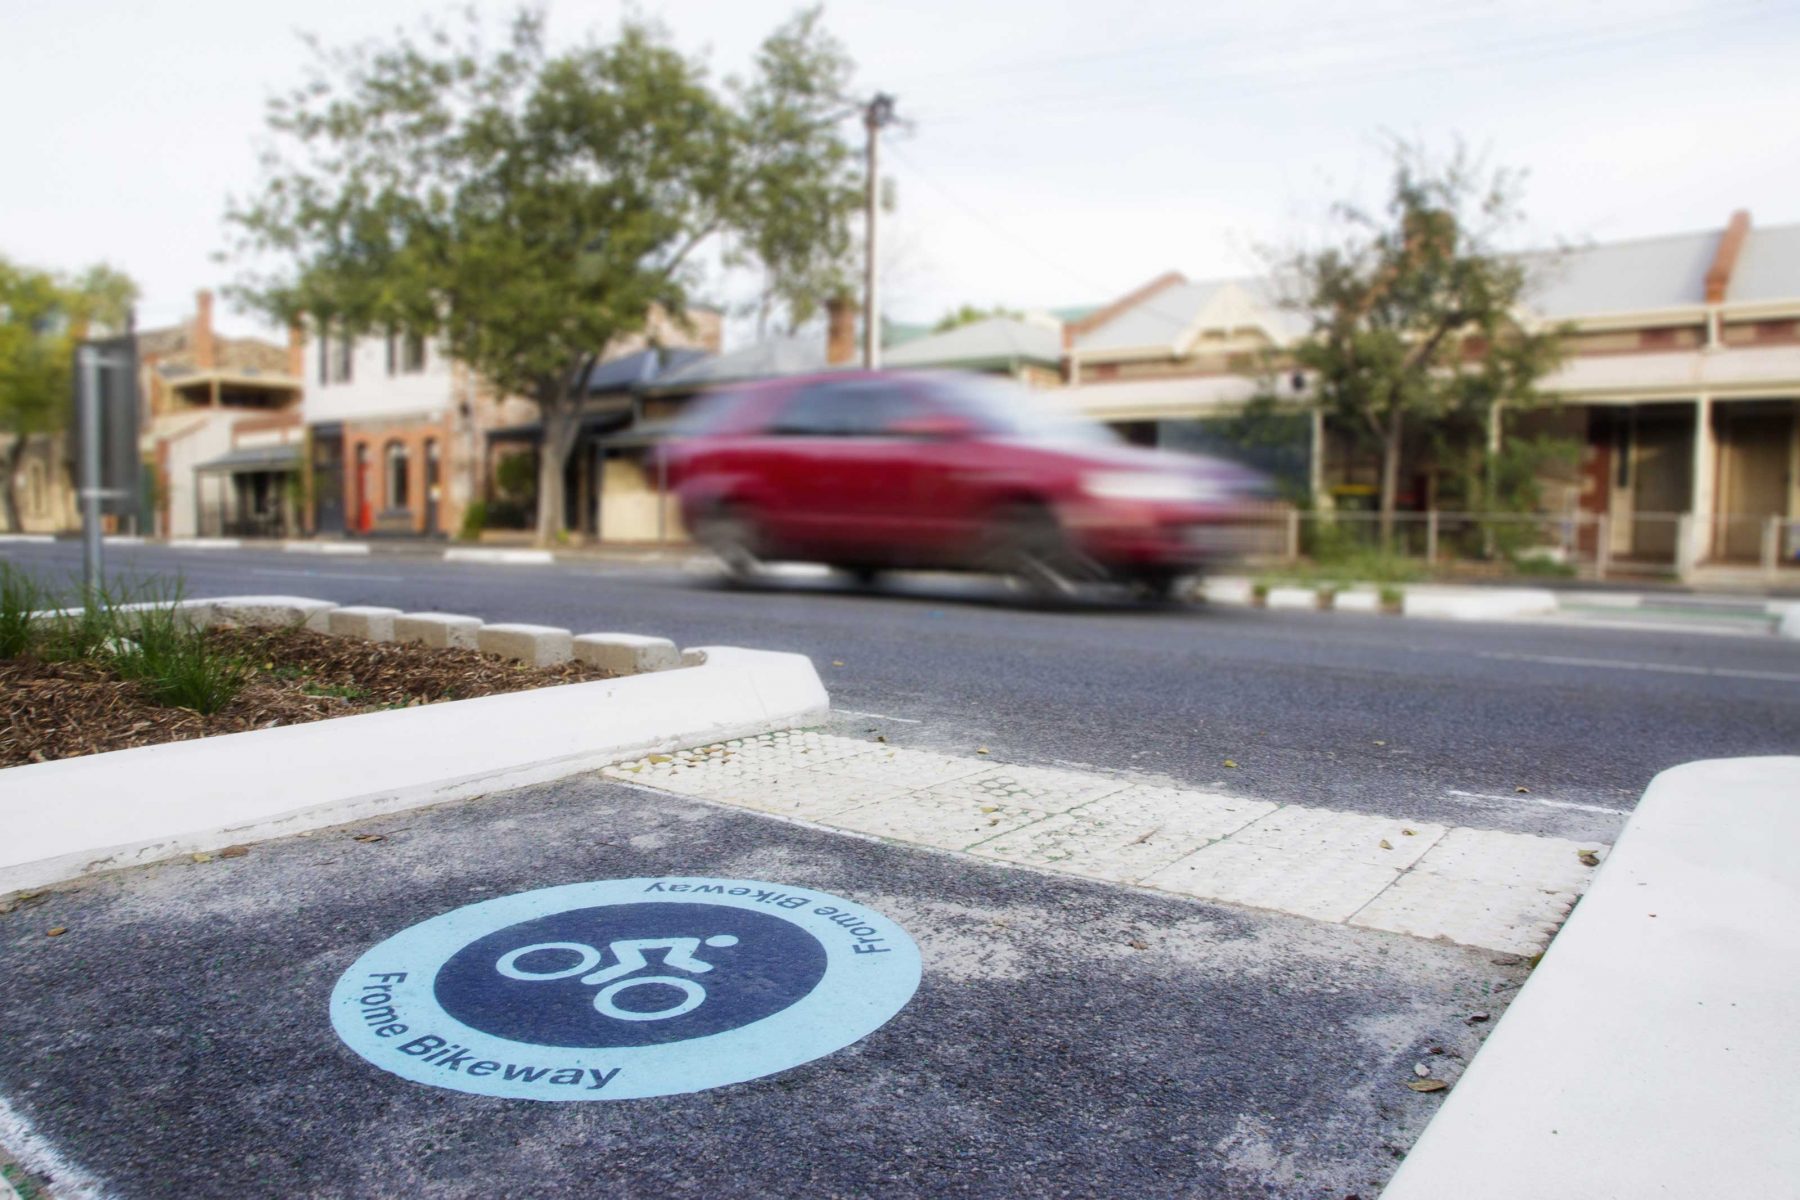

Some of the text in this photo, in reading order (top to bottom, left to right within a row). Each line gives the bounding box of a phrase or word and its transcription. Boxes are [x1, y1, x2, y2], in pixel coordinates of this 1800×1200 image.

[646, 882, 891, 955] Frome Bikeway
[360, 972, 621, 1089] Frome Bikeway
